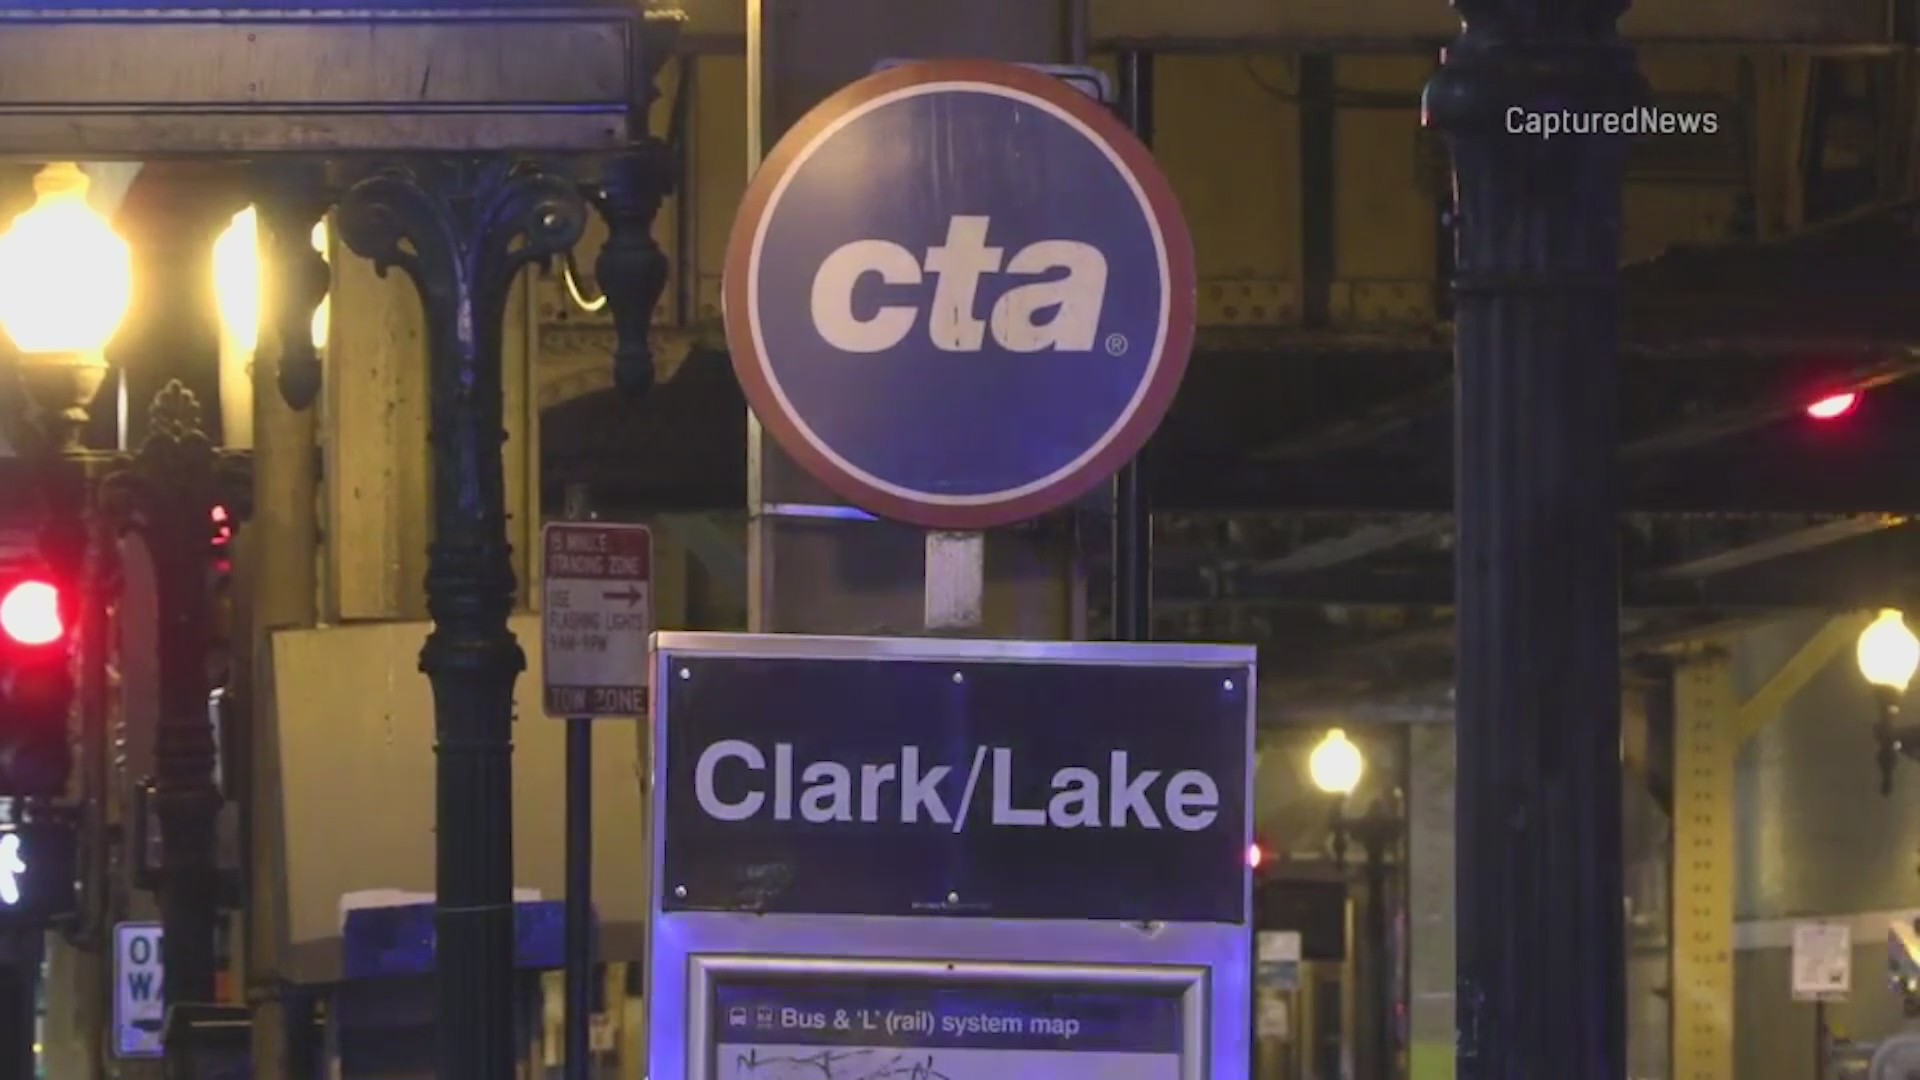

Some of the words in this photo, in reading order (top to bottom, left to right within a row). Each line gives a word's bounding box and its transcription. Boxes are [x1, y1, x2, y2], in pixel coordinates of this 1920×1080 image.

[810, 215, 1108, 352] cta
[608, 556, 641, 575] ZONE
[551, 688, 586, 711] TOW
[595, 689, 645, 712] ZONE
[694, 739, 1220, 833] Clark/Lake
[781, 1007, 826, 1029] Bus
[833, 1009, 849, 1029] &
[886, 1010, 935, 1036] (rail)
[942, 1013, 1023, 1037] system
[1030, 1017, 1080, 1040] map
